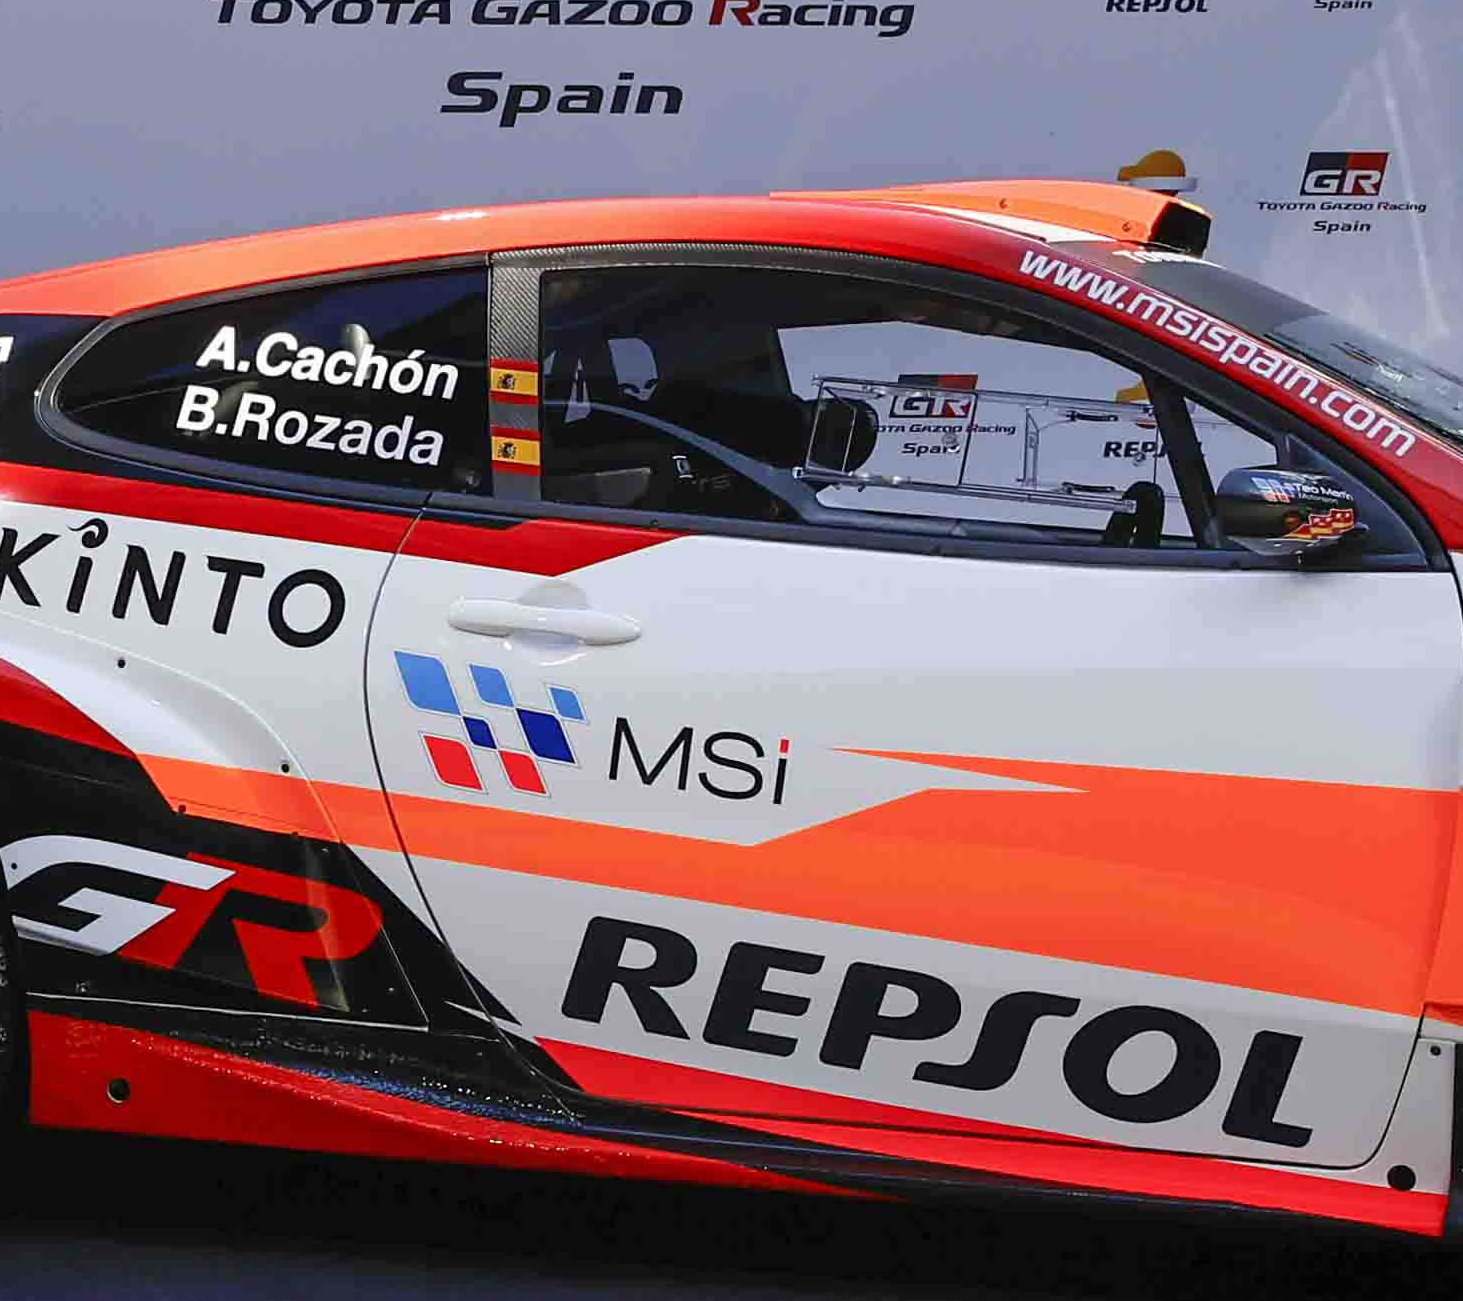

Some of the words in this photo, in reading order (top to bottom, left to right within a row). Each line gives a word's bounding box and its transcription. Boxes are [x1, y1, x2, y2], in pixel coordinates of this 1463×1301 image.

[440, 72, 682, 128] Spain
[1258, 202, 1315, 210] TOYOTA
[1320, 202, 1374, 210] GAZOO
[1377, 202, 1426, 213] Racing
[1307, 169, 1381, 194] GR
[1314, 220, 1370, 234] Spain
[196, 326, 458, 400] A.Cachón
[1017, 249, 1419, 458] www.msispain.com
[176, 386, 443, 466] B.Rozada
[909, 424, 962, 433] GAZOO
[970, 424, 1016, 435] Racing
[609, 718, 789, 805] MSi
[561, 916, 1315, 1148] REPSOL
